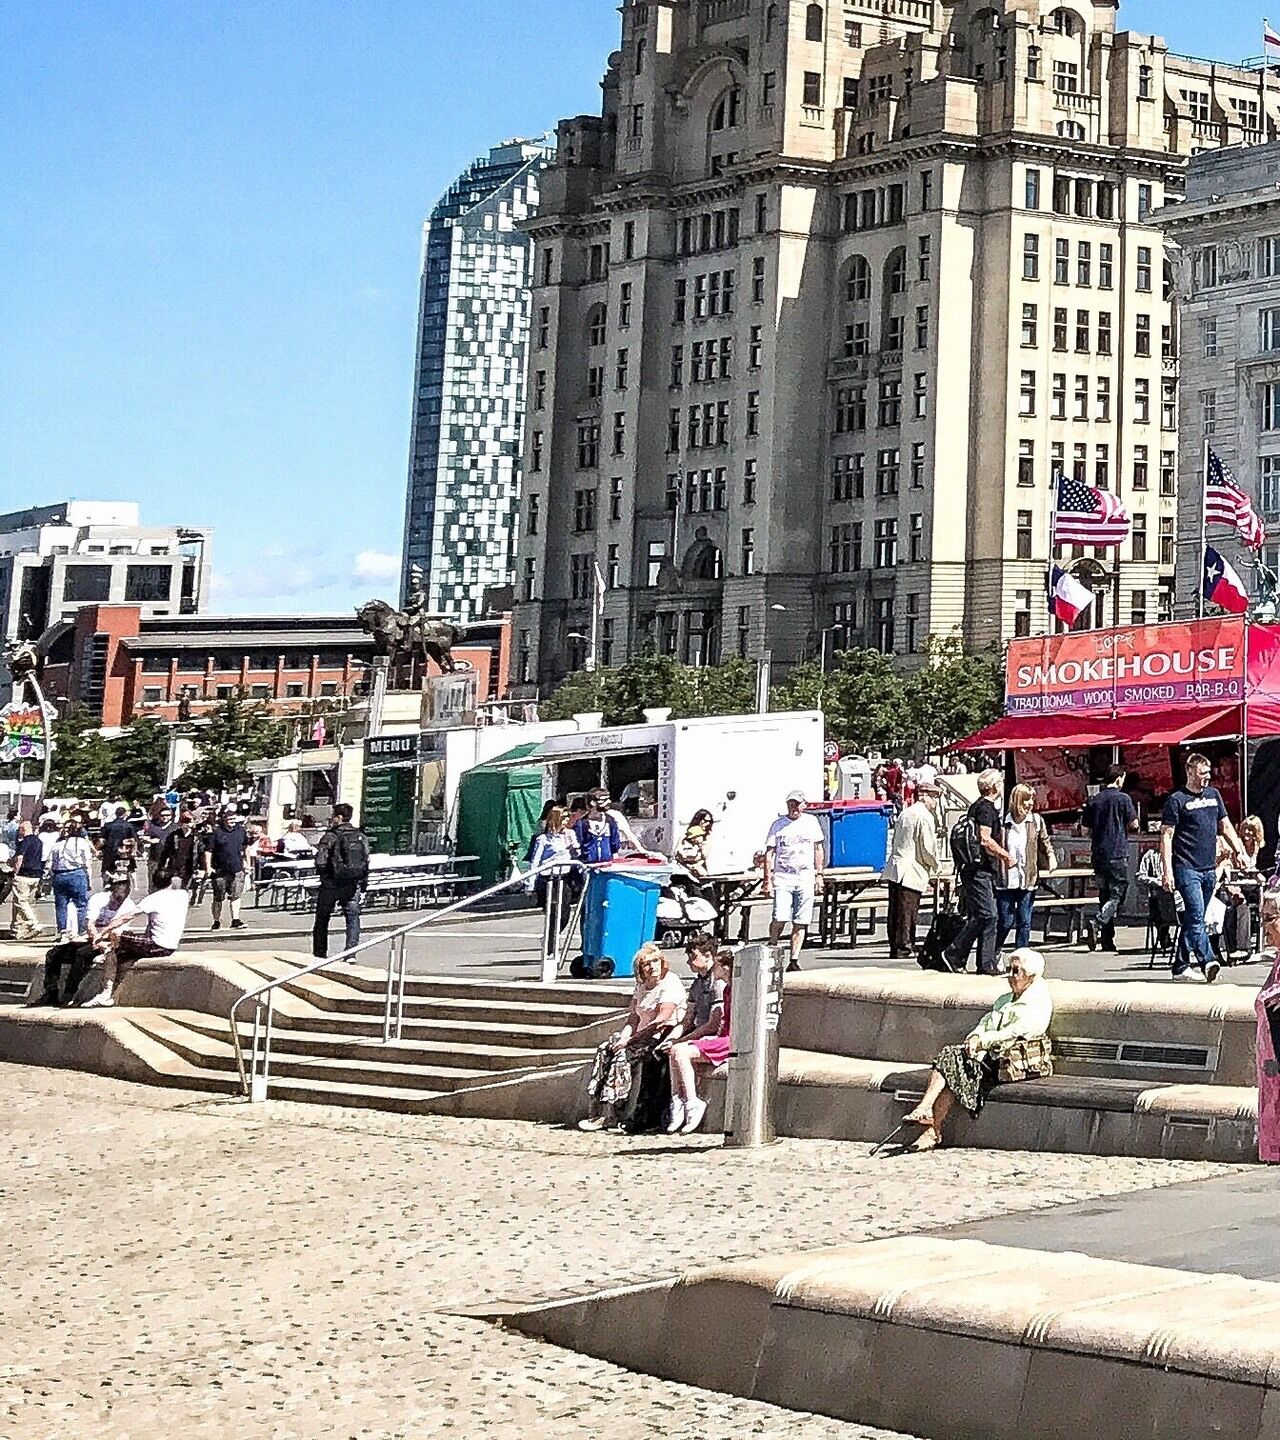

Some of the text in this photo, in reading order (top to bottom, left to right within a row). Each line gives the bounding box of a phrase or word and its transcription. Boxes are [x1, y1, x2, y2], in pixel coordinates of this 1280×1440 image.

[1017, 647, 1236, 688] SMOKEHOUSE
[1013, 680, 1238, 710] TRADITIONAL WOOD SMOKED BAR-B-Q
[370, 738, 411, 753] MENU
